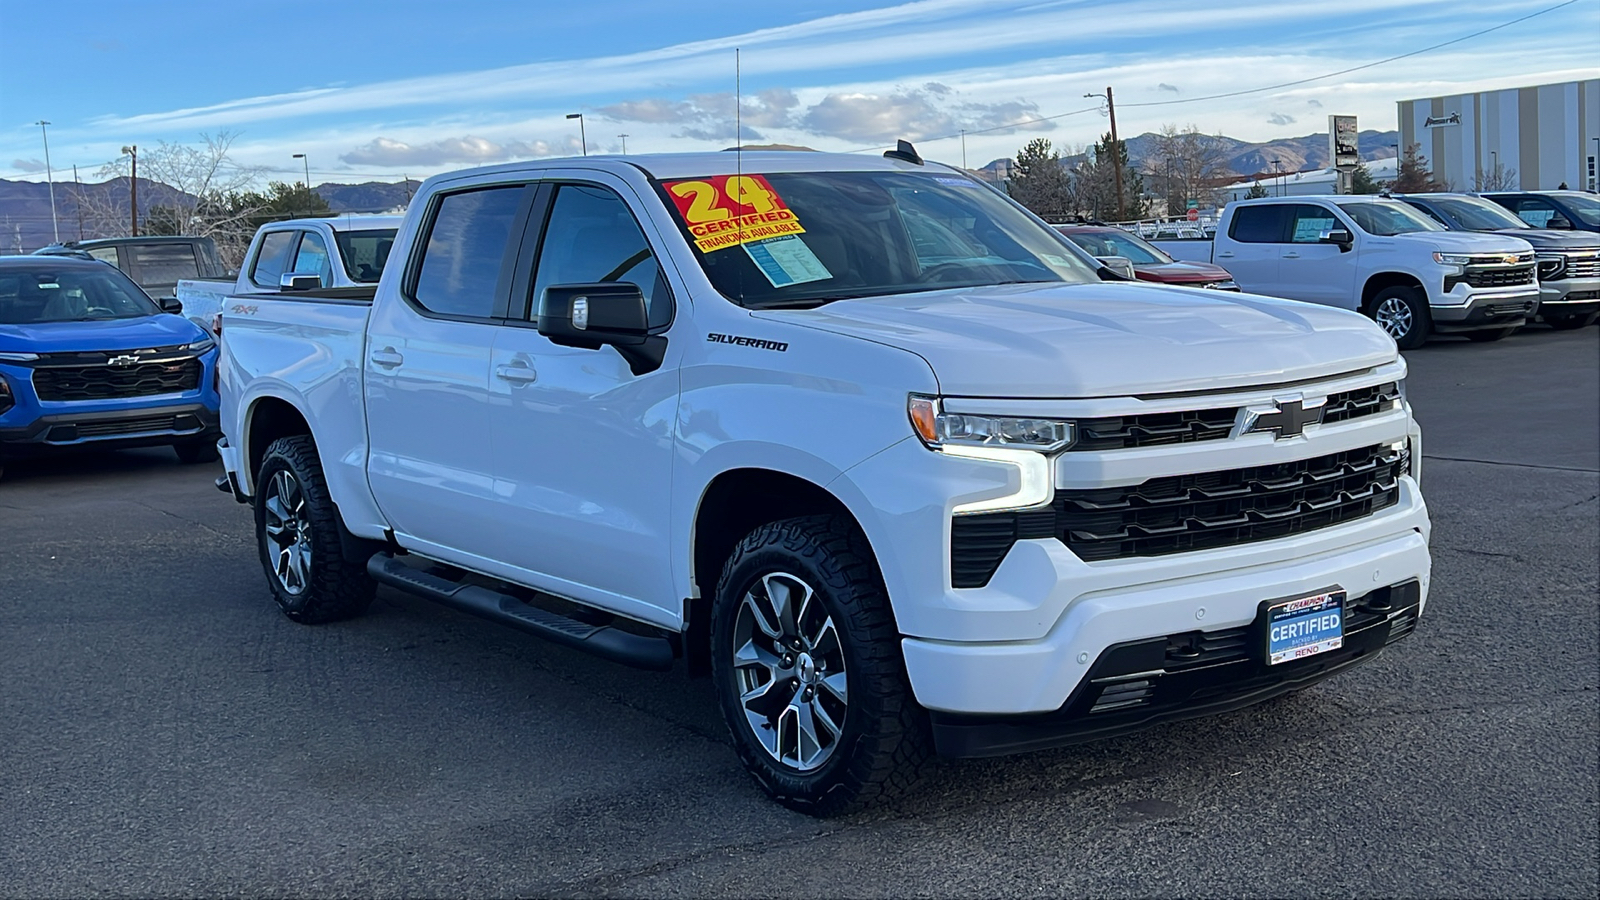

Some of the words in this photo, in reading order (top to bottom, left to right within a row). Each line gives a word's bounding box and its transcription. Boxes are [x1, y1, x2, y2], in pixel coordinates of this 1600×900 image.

[671, 175, 776, 223] 24
[692, 211, 793, 236] CERTIFIED
[698, 230, 751, 250] FINANCING
[752, 222, 801, 239] AVAILABLE
[706, 332, 789, 352] SILVERADO
[1288, 595, 1327, 611] CHAMPION
[1270, 614, 1340, 643] CERTIFIED
[1295, 645, 1319, 657] RENO
